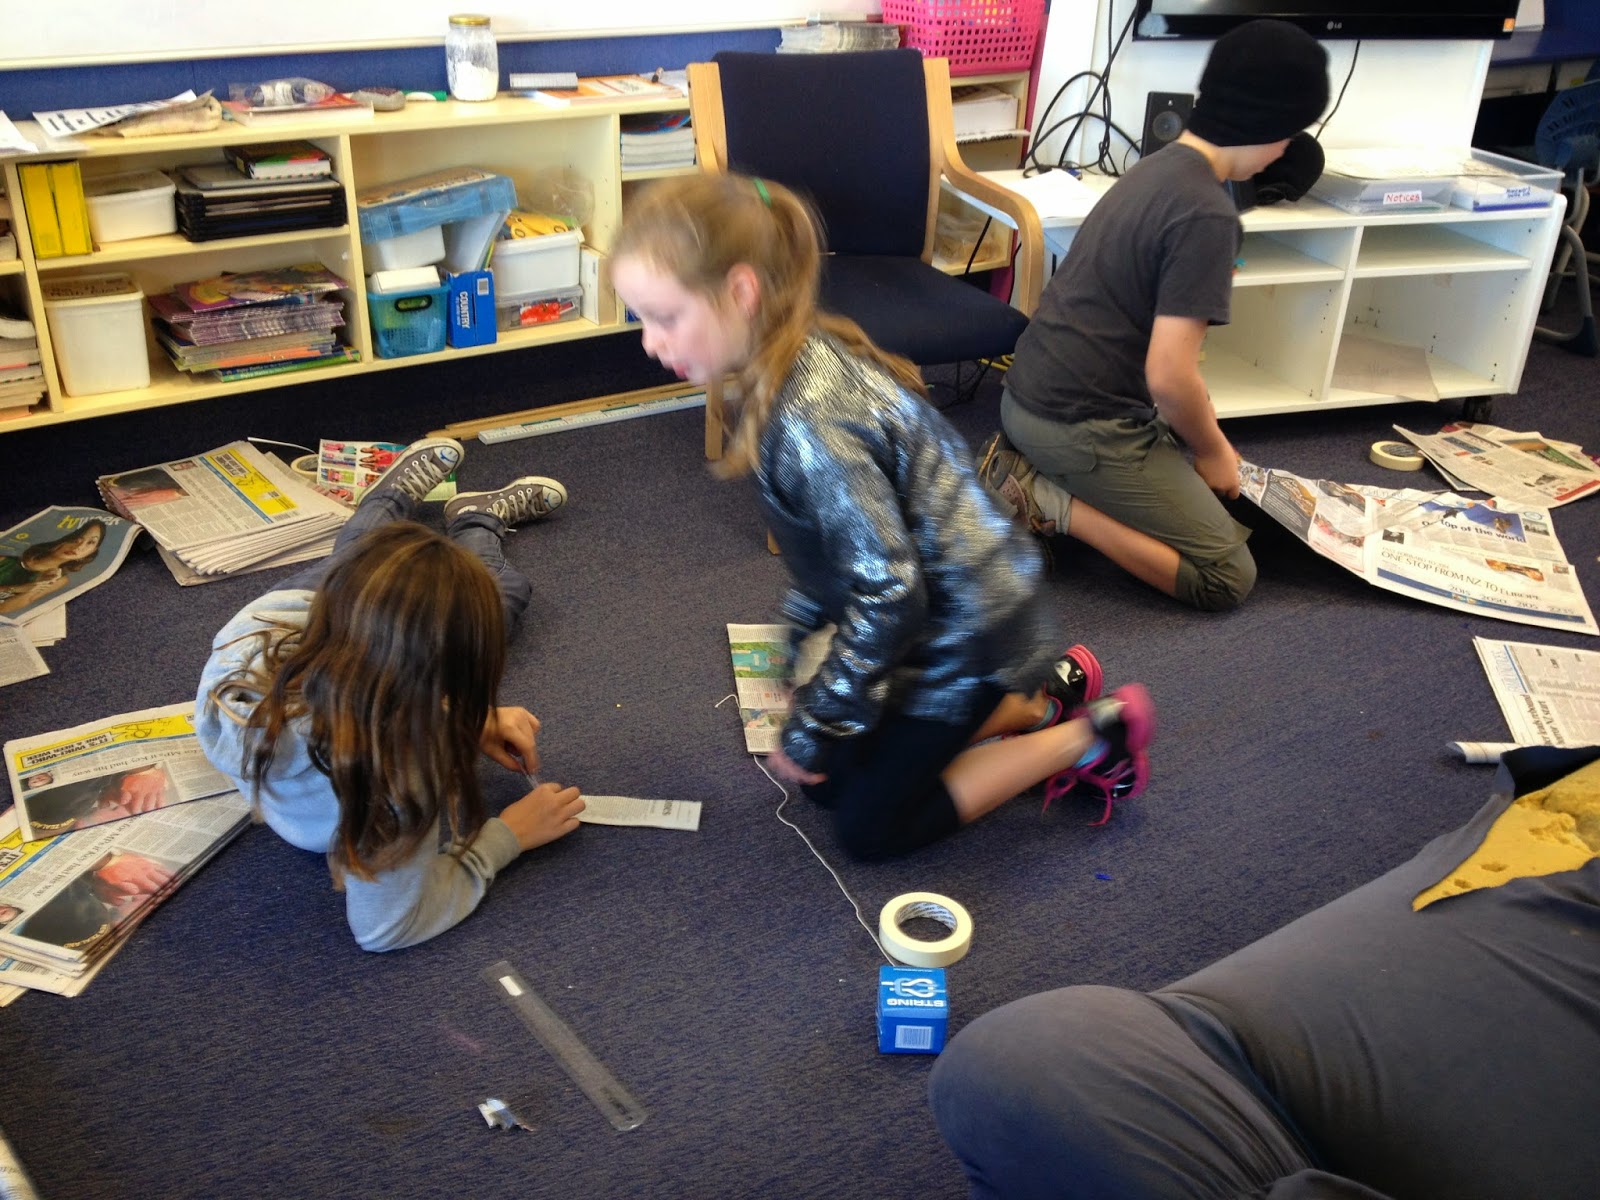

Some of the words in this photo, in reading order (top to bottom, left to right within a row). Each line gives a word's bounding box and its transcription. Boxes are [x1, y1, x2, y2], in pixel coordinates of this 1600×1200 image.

[1386, 193, 1420, 203] Notices
[459, 291, 471, 329] COUNTRY
[1441, 519, 1458, 530] top
[1475, 527, 1493, 537] the
[1495, 533, 1527, 544] world
[1381, 550, 1403, 562] ONE
[1406, 558, 1433, 571] STOP
[1434, 566, 1464, 581] FROM
[1466, 575, 1482, 586] NZ
[1485, 581, 1499, 592] TO
[1500, 588, 1541, 601] EUROPE
[110, 760, 128, 770] had
[72, 769, 91, 777] way
[76, 850, 96, 862] Key
[62, 862, 81, 875] had
[886, 998, 945, 1008] STRING
